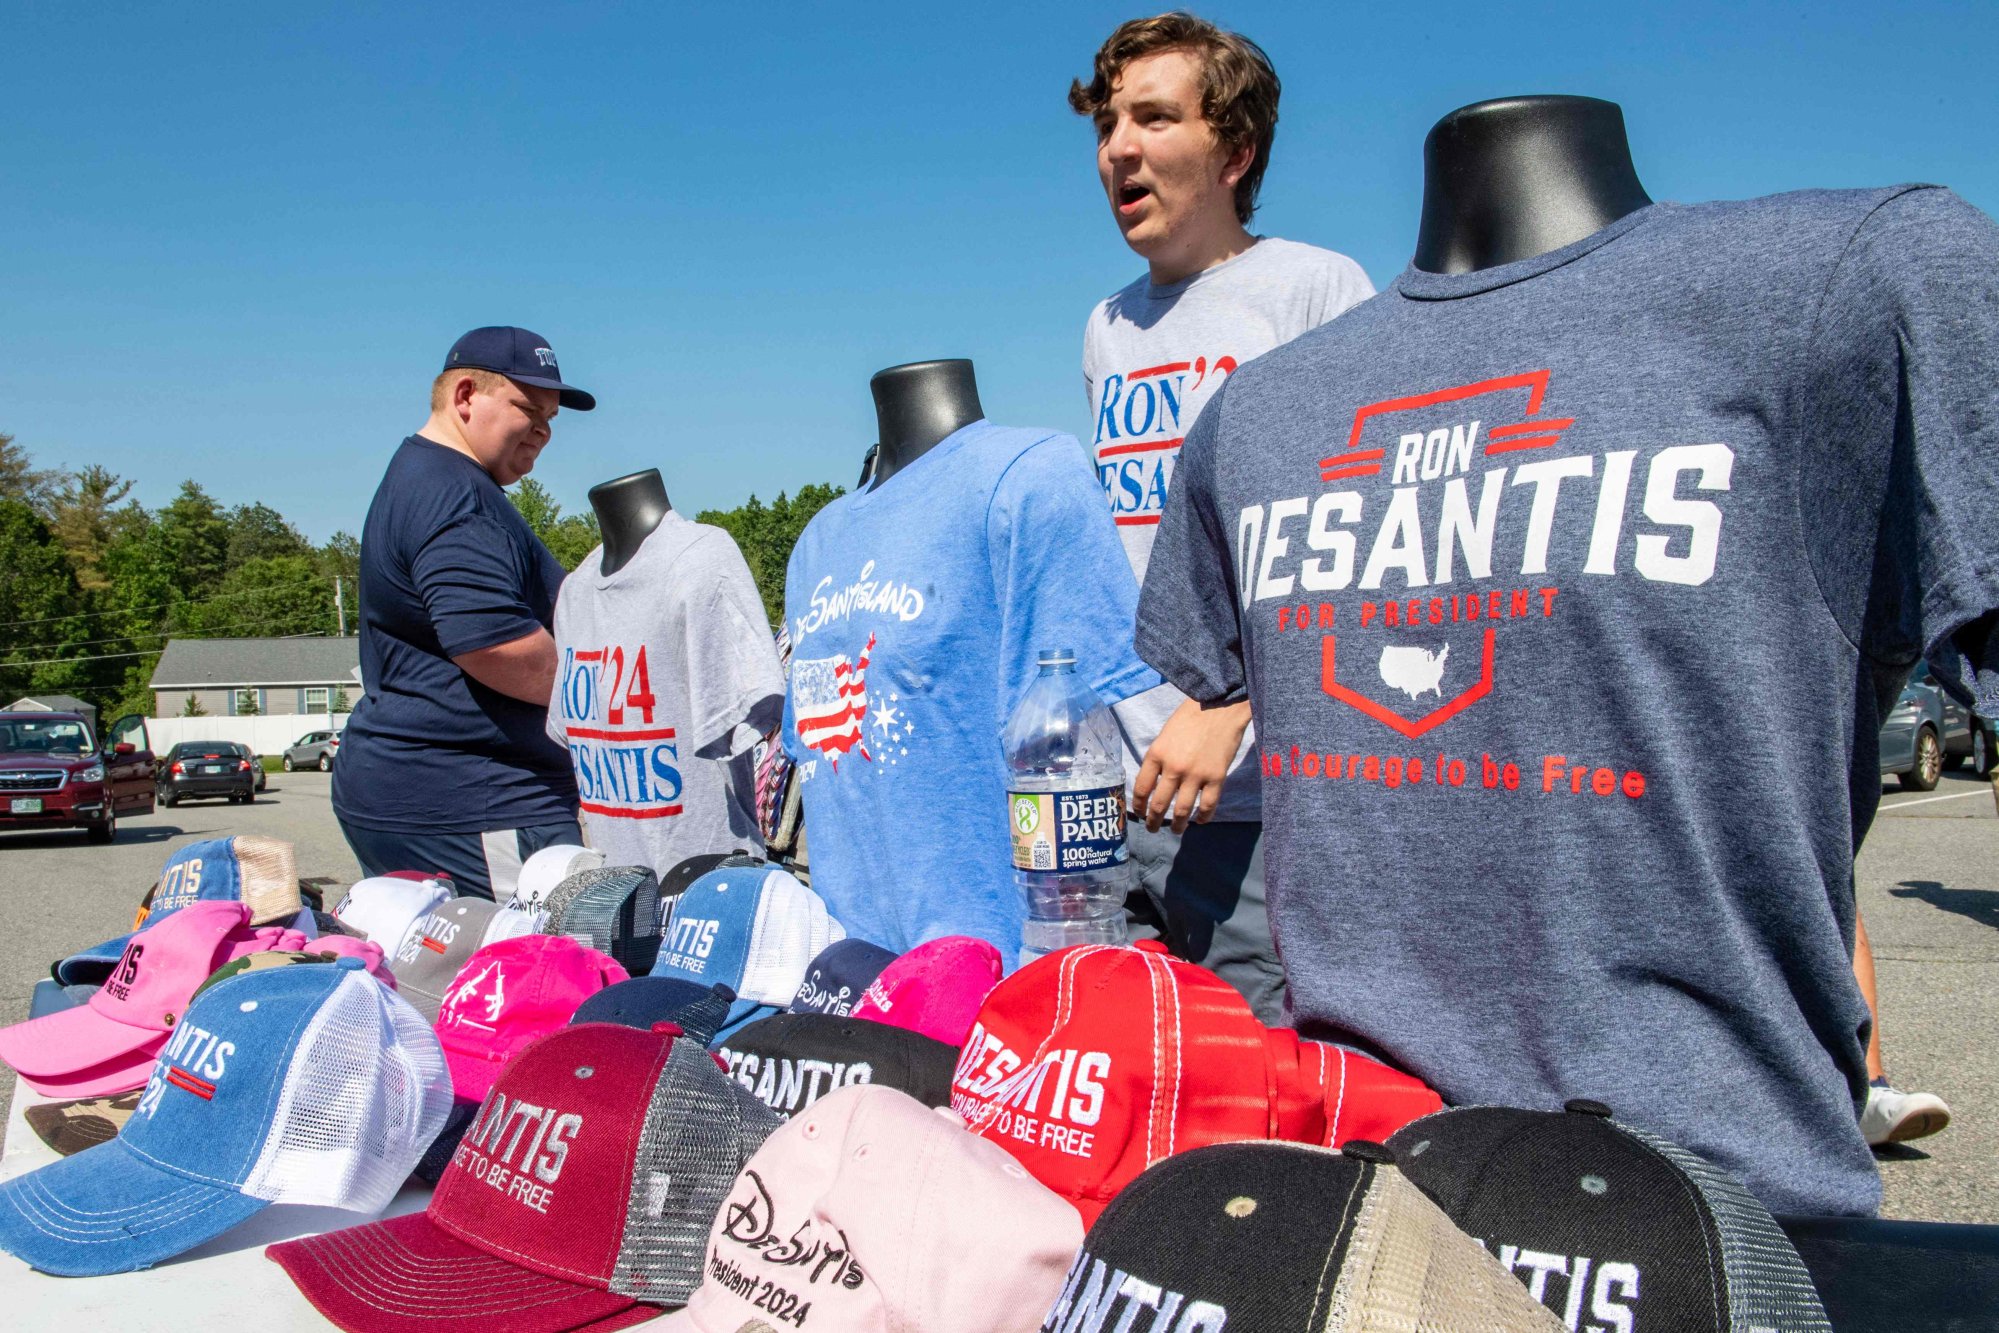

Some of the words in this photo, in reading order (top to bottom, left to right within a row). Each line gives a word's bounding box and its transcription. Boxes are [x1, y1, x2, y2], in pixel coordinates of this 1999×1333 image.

[1094, 374, 1186, 445] RON
[1392, 420, 1481, 486] RON
[1099, 455, 1170, 513] ESA
[1238, 444, 1735, 612] DESANTIS
[1278, 603, 1335, 633] FOR
[1361, 587, 1560, 627] PRESIDENT
[569, 743, 683, 803] ESANTIS
[1261, 747, 1282, 778] he
[1290, 744, 1423, 789] Courage
[1436, 753, 1466, 786] to
[1482, 753, 1521, 790] be
[1542, 755, 1646, 798] Free
[1060, 796, 1118, 821] DEER
[1061, 816, 1120, 843] PARK
[1062, 859, 1087, 868] spring
[1088, 857, 1108, 866] water
[1087, 848, 1113, 858] natural
[681, 956, 706, 974] FREE
[797, 970, 851, 1017] ESANTIS
[165, 1021, 235, 1080] NTIS
[463, 1085, 583, 1184] ANTIS
[1012, 1114, 1038, 1144] BE
[1041, 1122, 1095, 1158] FREE
[467, 1151, 488, 1179] TO
[487, 1164, 511, 1192] BE
[507, 1175, 554, 1215] FREE
[754, 1281, 812, 1328] 2024
